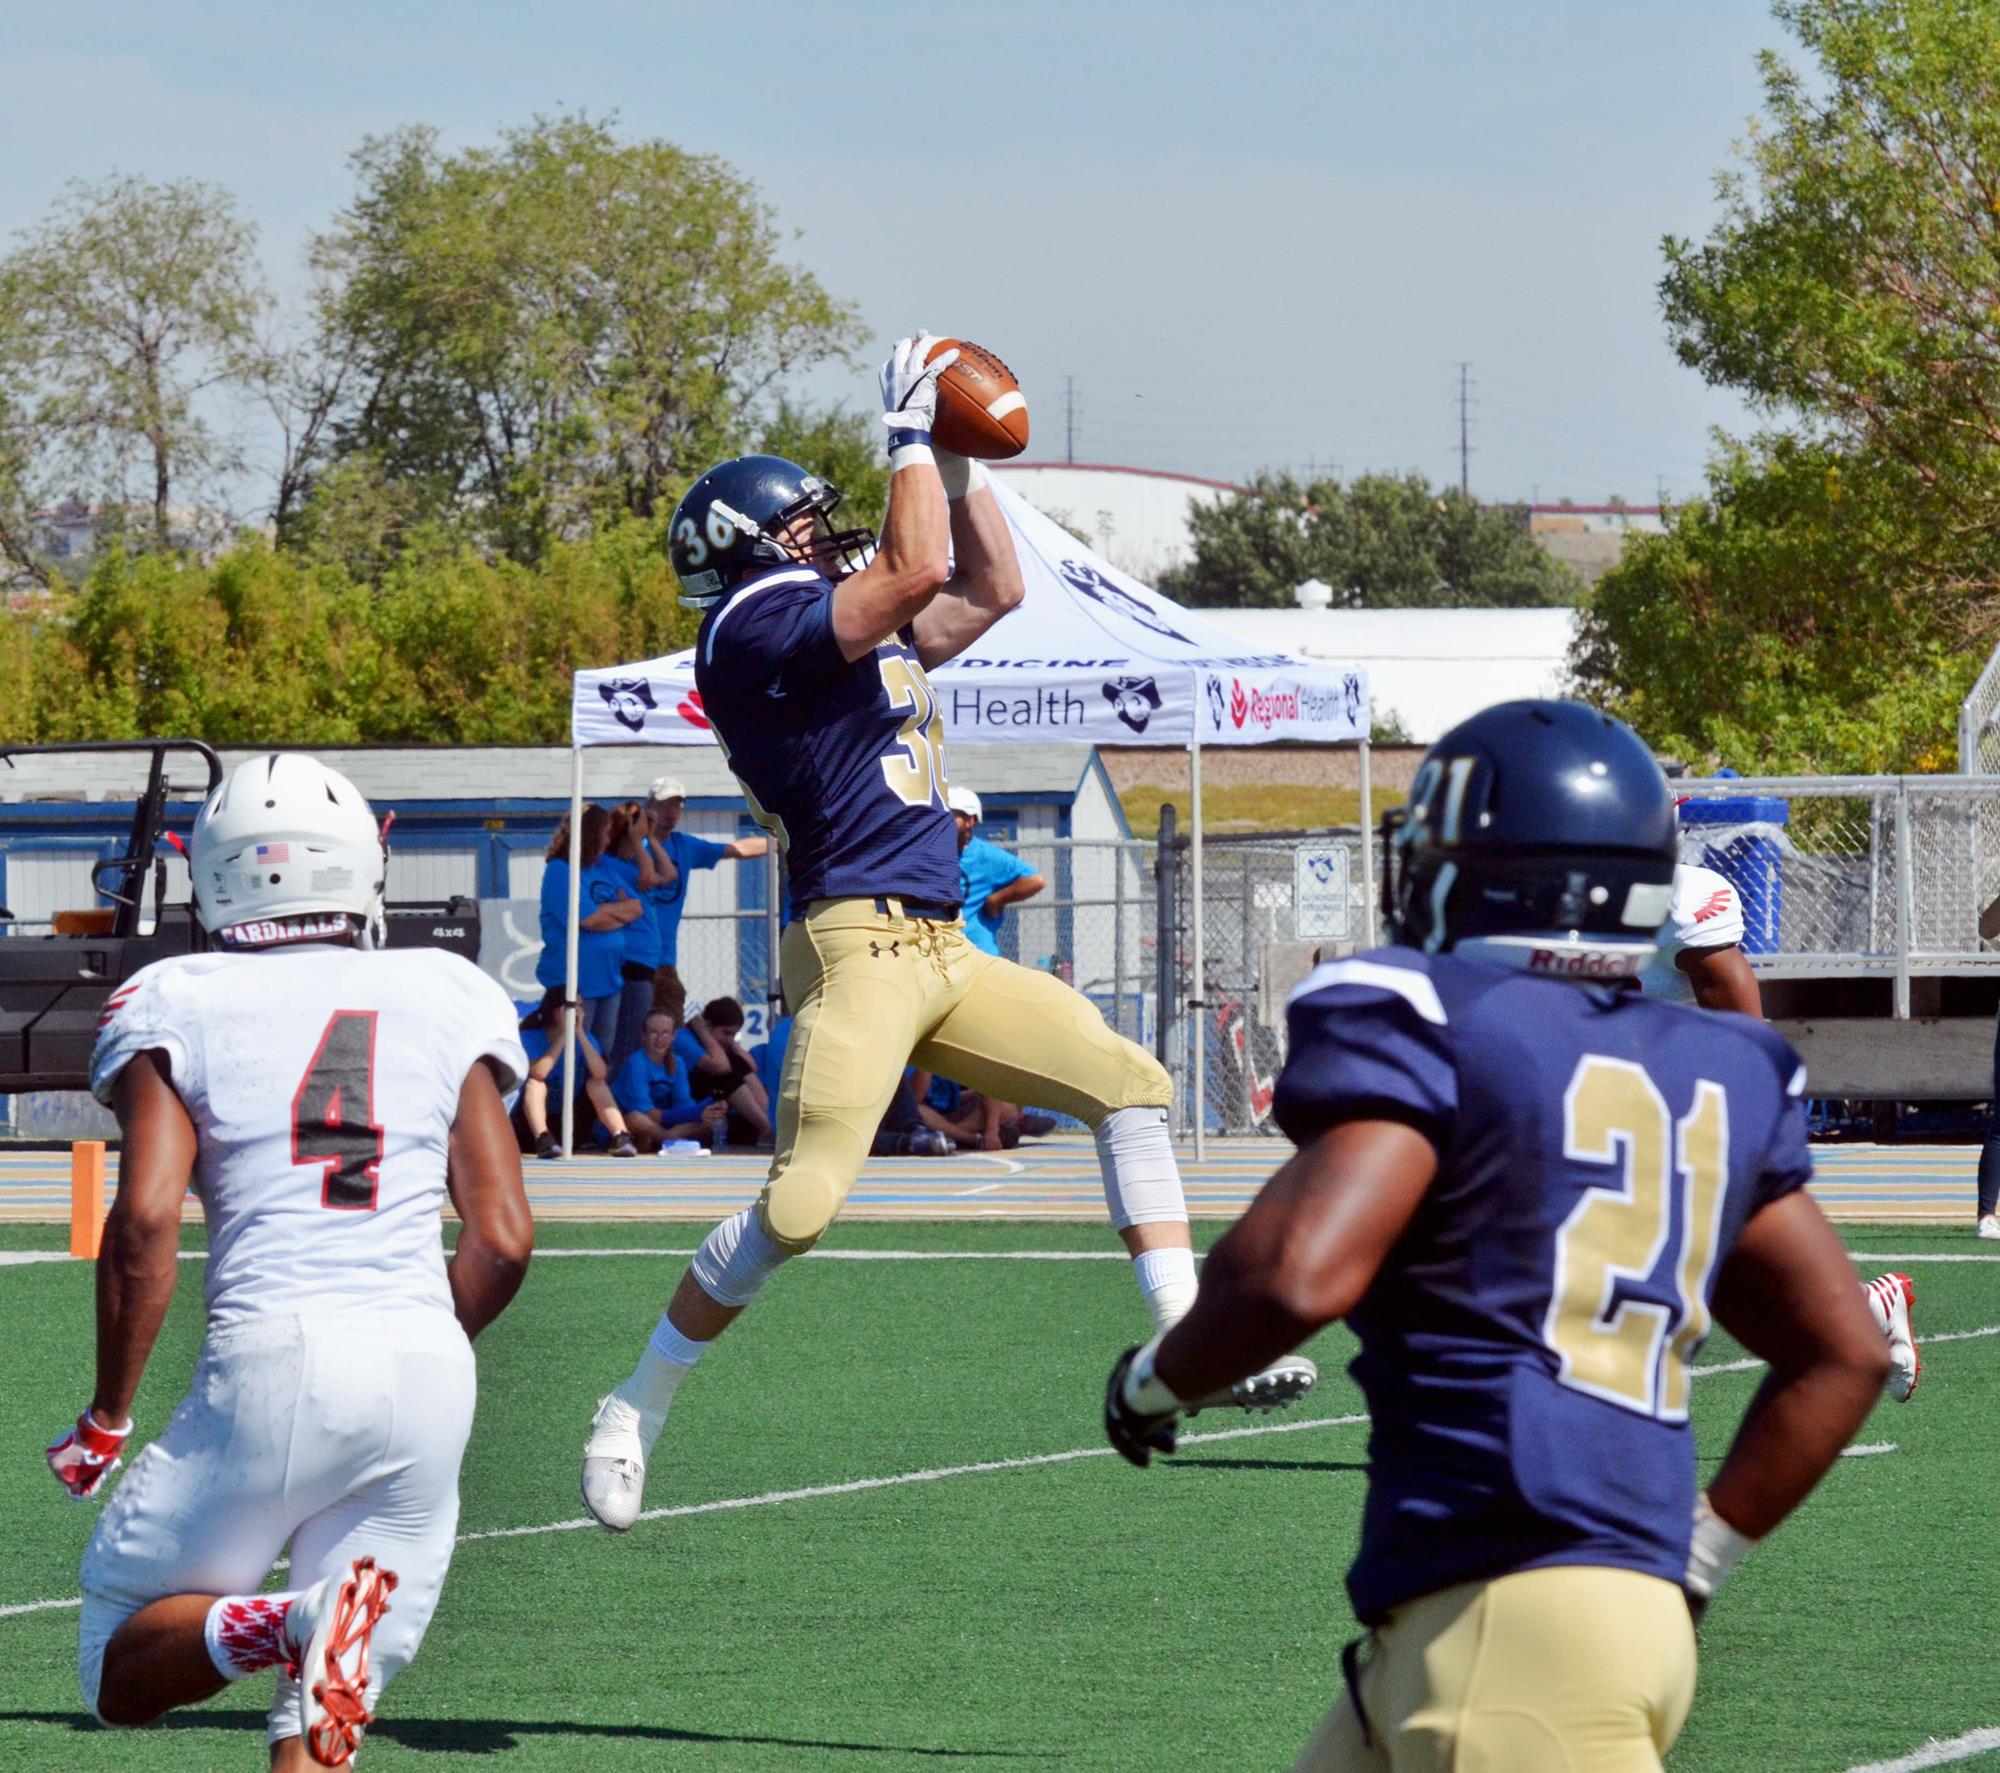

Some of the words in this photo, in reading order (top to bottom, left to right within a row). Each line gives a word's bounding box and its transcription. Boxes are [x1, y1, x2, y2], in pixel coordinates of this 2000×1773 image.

[677, 509, 737, 567] 36
[952, 688, 1085, 726] Health
[1250, 684, 1300, 730] Regional
[1300, 685, 1340, 722] Health
[1392, 756, 1476, 848] 21
[220, 912, 348, 944] CARDINALS
[431, 927, 466, 938] 4x4
[291, 1009, 384, 1212] 4
[1543, 1053, 1730, 1422] 21
